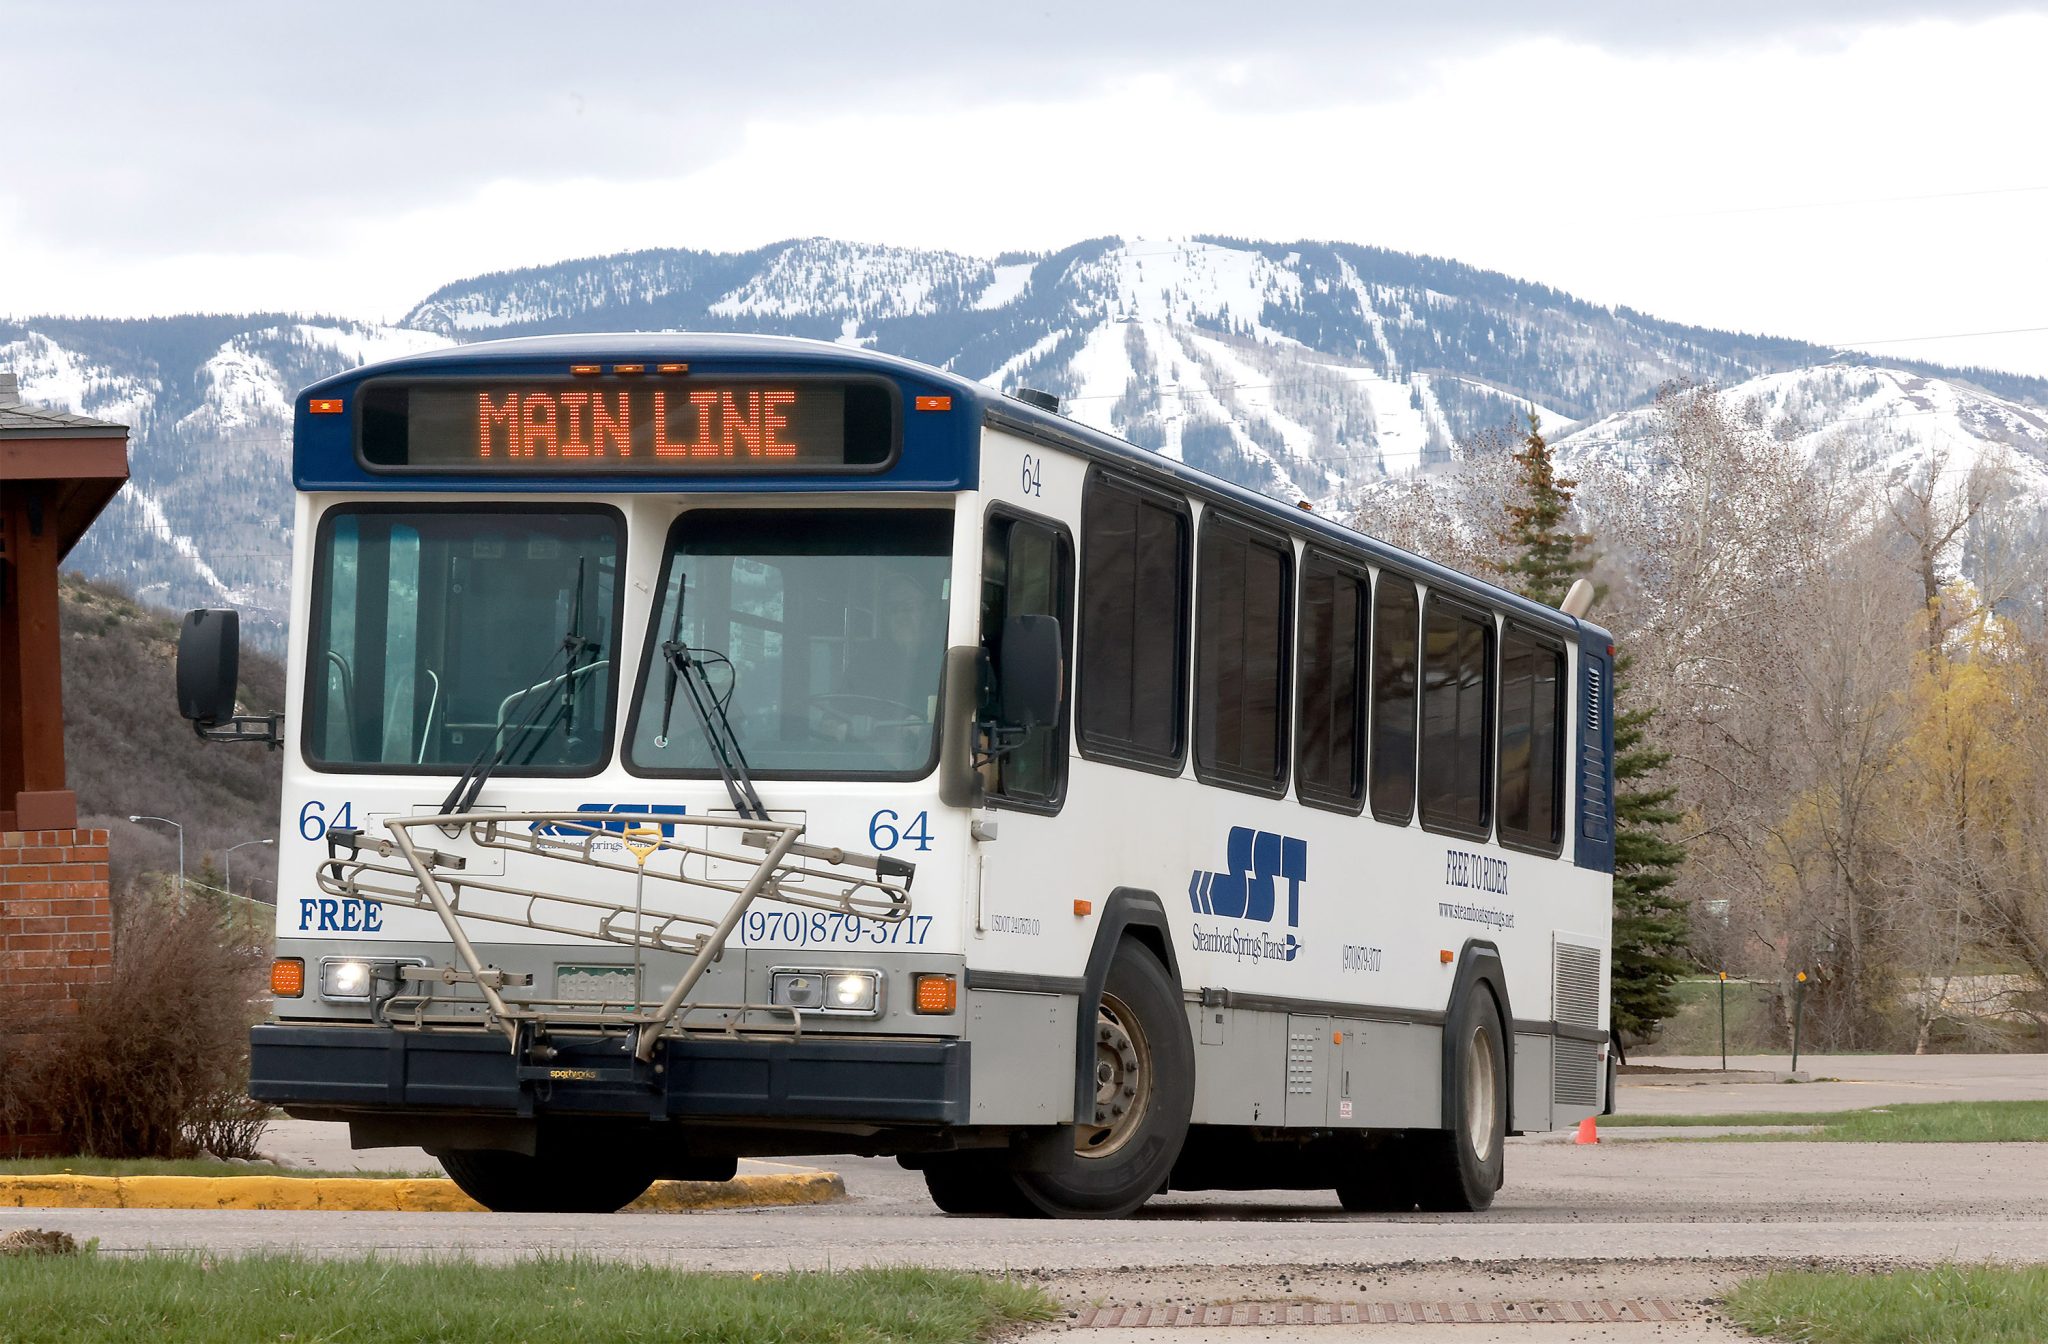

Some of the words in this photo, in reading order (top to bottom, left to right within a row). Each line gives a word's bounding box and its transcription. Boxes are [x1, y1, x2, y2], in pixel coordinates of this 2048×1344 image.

[479, 391, 631, 457] MAIN
[655, 390, 796, 456] LINE
[1022, 453, 1041, 497] 64
[299, 800, 358, 841] 64
[868, 809, 935, 851] 64
[1210, 825, 1307, 927] SST
[1446, 850, 1469, 887] FREE
[1471, 854, 1482, 890] TO
[1483, 856, 1508, 895] RIDER
[299, 898, 383, 932] FREE
[741, 911, 933, 947] (970)879-3717
[1192, 923, 1232, 954] Steamboat
[1233, 928, 1262, 965] Springs
[1262, 932, 1286, 961] Transit
[1342, 944, 1382, 973] (970)879-3717
